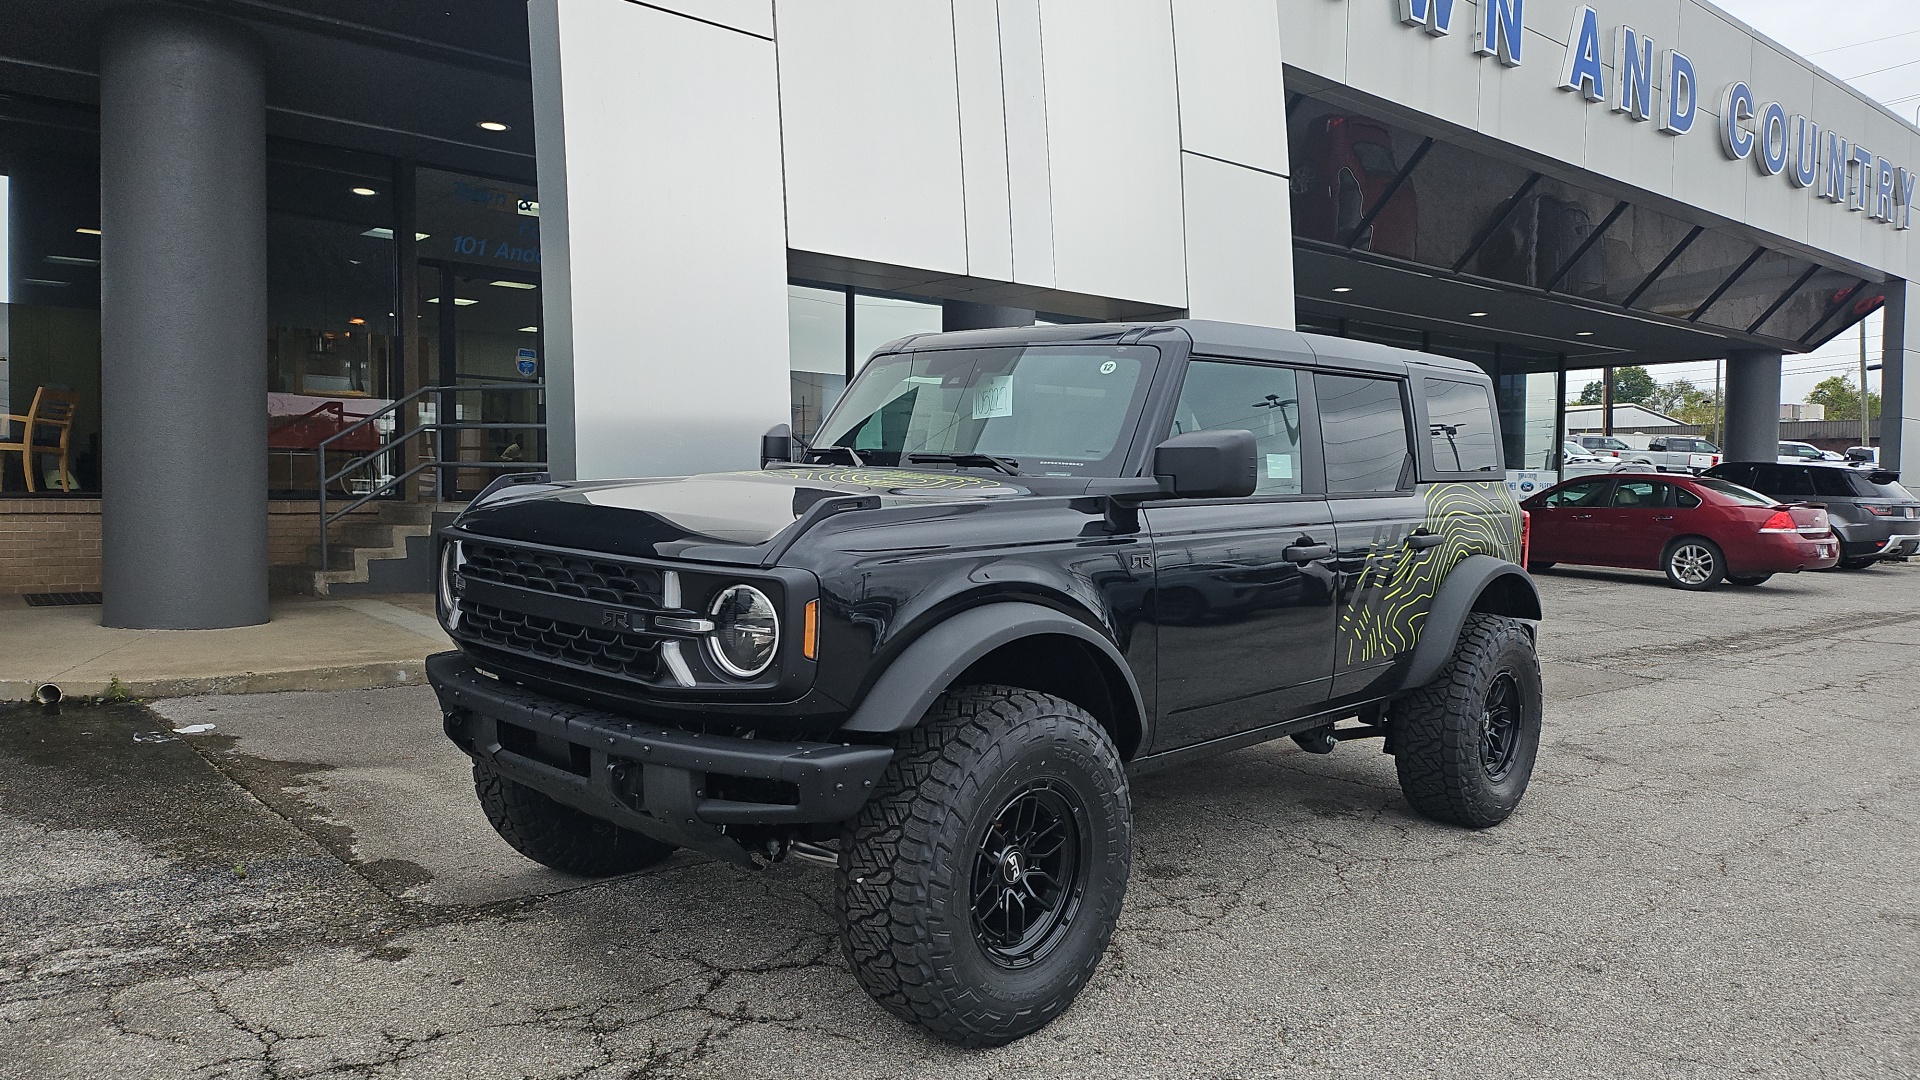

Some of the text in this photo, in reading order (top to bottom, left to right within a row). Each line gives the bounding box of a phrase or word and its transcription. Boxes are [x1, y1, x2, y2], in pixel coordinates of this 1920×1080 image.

[1559, 4, 1698, 136] AND
[1719, 81, 1917, 230] COUNTRY
[519, 193, 533, 211] &
[453, 234, 487, 256] 101
